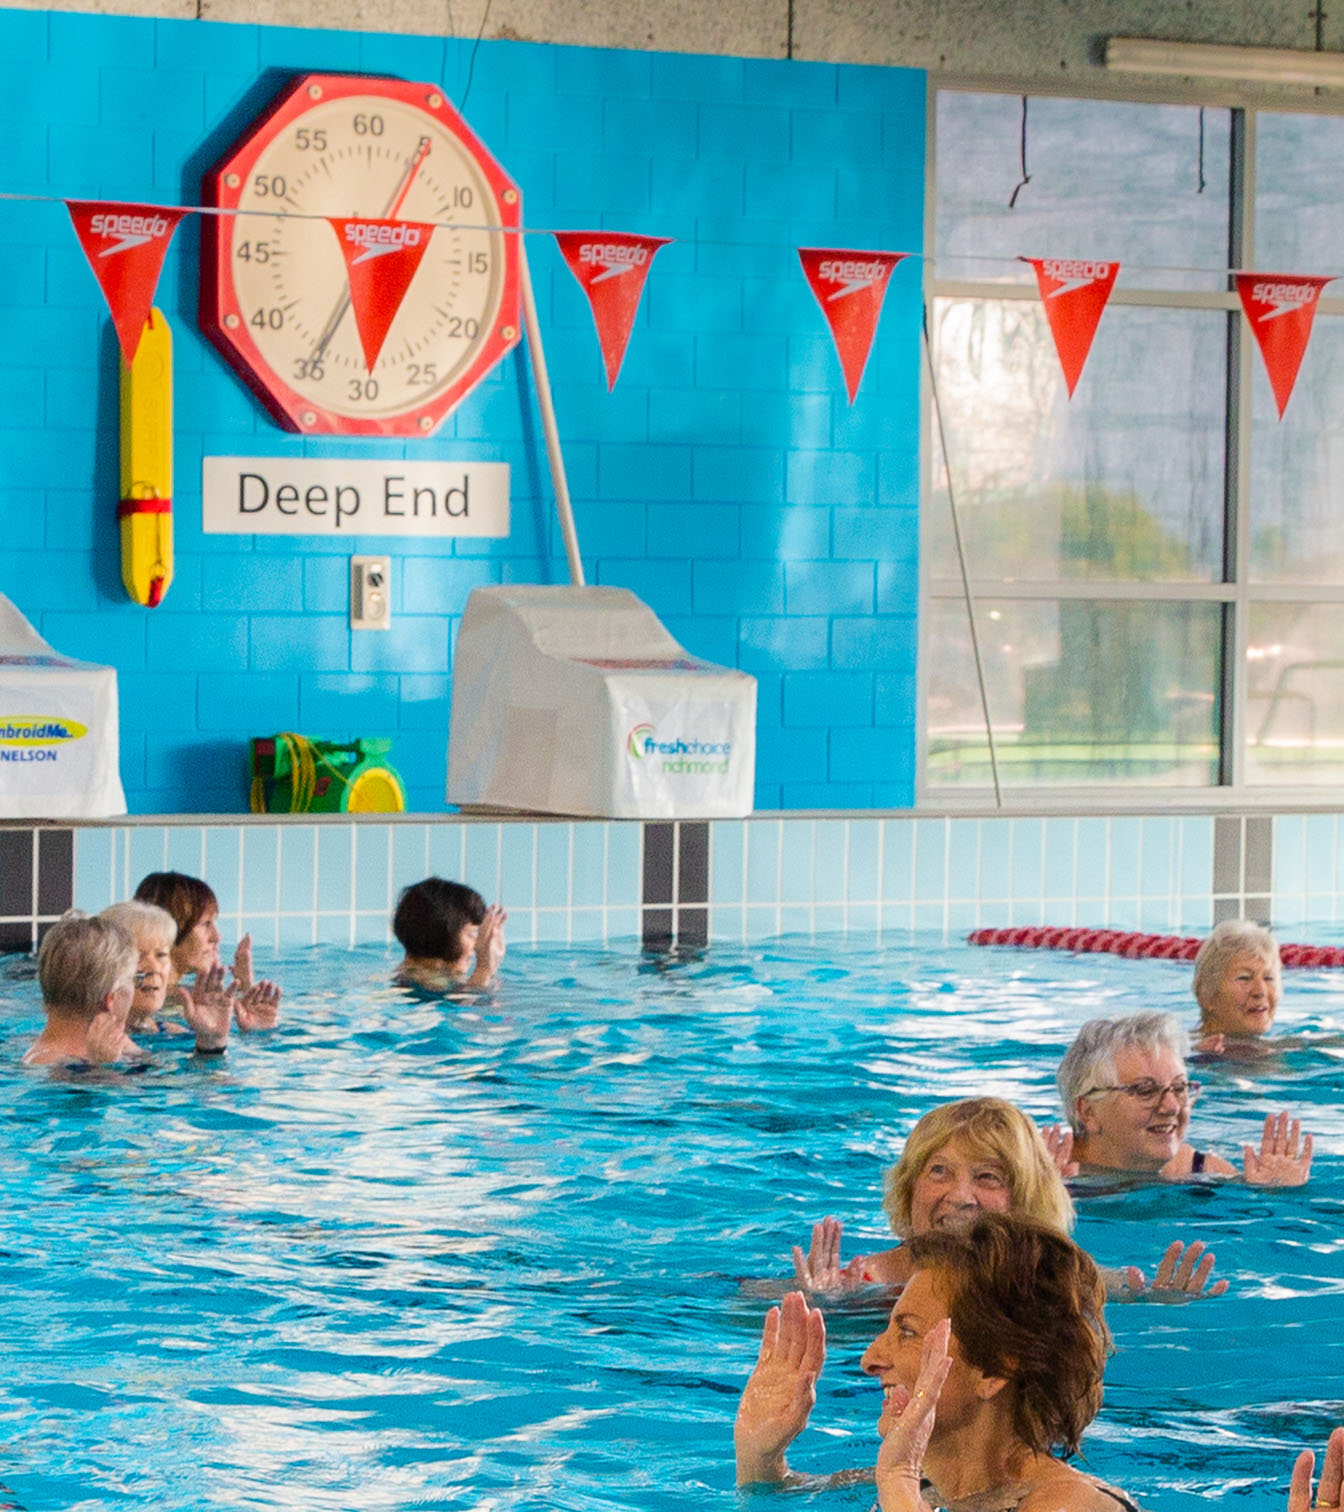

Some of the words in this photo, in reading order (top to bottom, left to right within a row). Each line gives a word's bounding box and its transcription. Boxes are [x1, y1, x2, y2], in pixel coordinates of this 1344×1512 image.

[353, 114, 384, 137] 60
[295, 129, 328, 152] 55
[253, 175, 287, 198] 50
[453, 187, 473, 209] 10
[90, 213, 168, 239] speedo
[344, 222, 421, 247] speedo
[237, 242, 270, 263] 45
[468, 252, 488, 274] 15
[579, 243, 648, 266] speedo
[818, 258, 887, 284] speedo
[1042, 259, 1109, 280] speedo
[1251, 282, 1316, 305] speedo
[251, 308, 284, 330] 40
[448, 317, 479, 339] 20
[406, 363, 438, 385] 25
[348, 379, 379, 401] 30
[238, 473, 361, 528] Deep
[383, 474, 470, 518] End
[0, 749, 58, 763] NELSON
[643, 736, 732, 756] freshchoice
